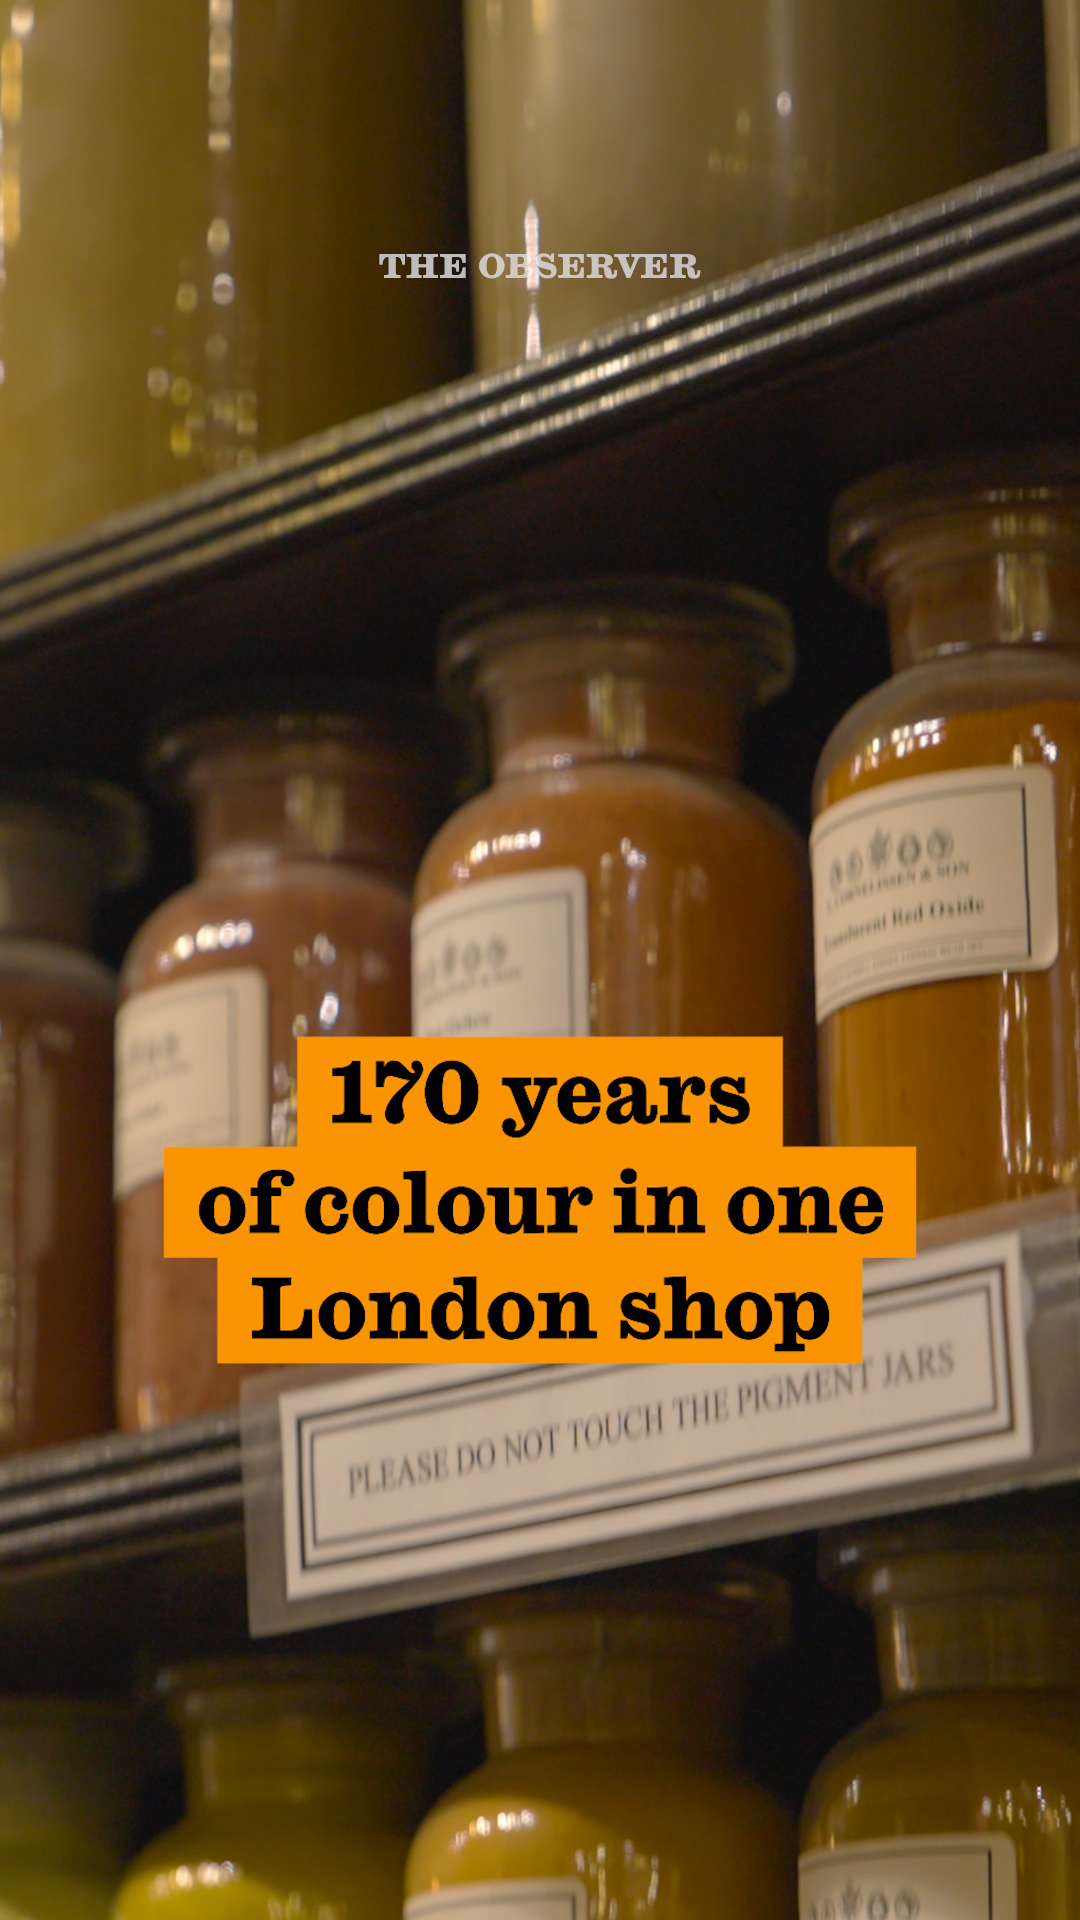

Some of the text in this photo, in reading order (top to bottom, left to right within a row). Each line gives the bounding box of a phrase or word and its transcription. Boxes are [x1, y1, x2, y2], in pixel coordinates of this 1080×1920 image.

[891, 901, 924, 928] Red
[928, 893, 986, 920] Oxide
[348, 1340, 956, 1498] PLEASE DO NOT TOUCH THE PIGMENT JARS
